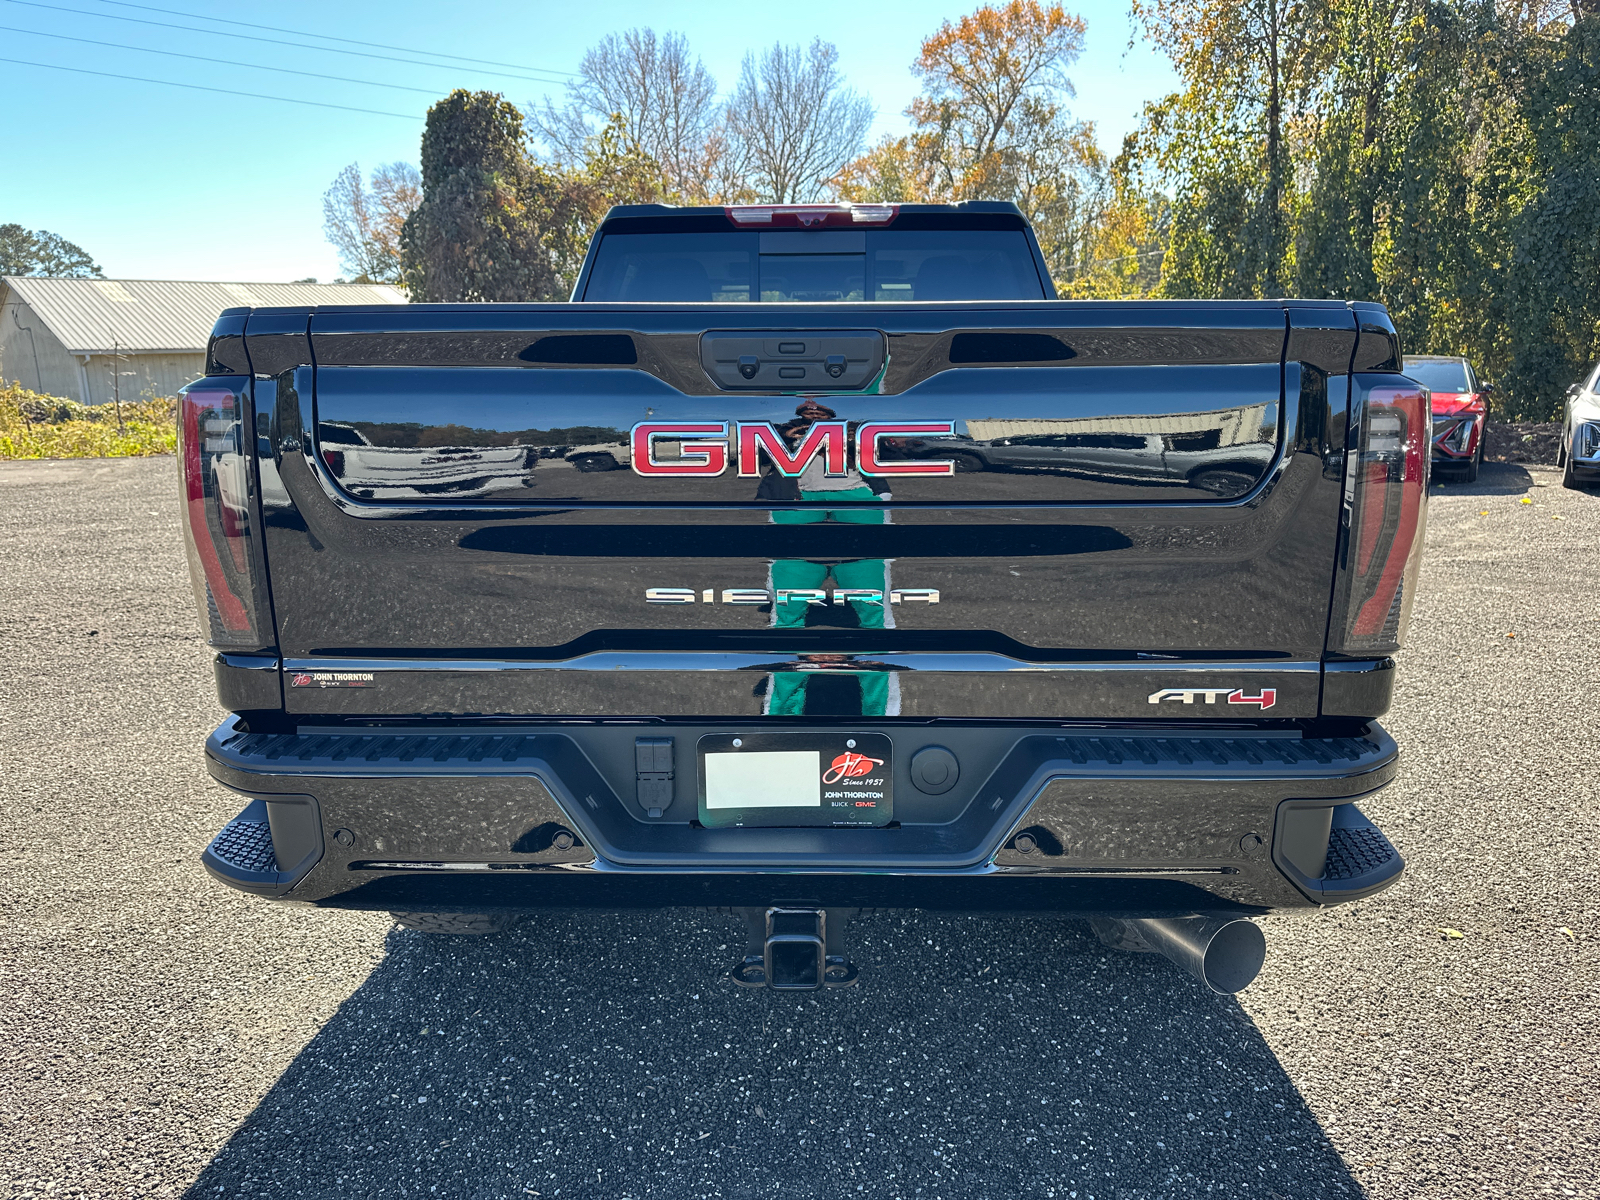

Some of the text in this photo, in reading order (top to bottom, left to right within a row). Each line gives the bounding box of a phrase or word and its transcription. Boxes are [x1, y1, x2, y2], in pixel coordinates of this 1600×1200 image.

[630, 419, 956, 478] GMC
[645, 588, 941, 606] SIERRA
[313, 673, 374, 681] JOHN THORNTON
[1148, 688, 1277, 710] AT4
